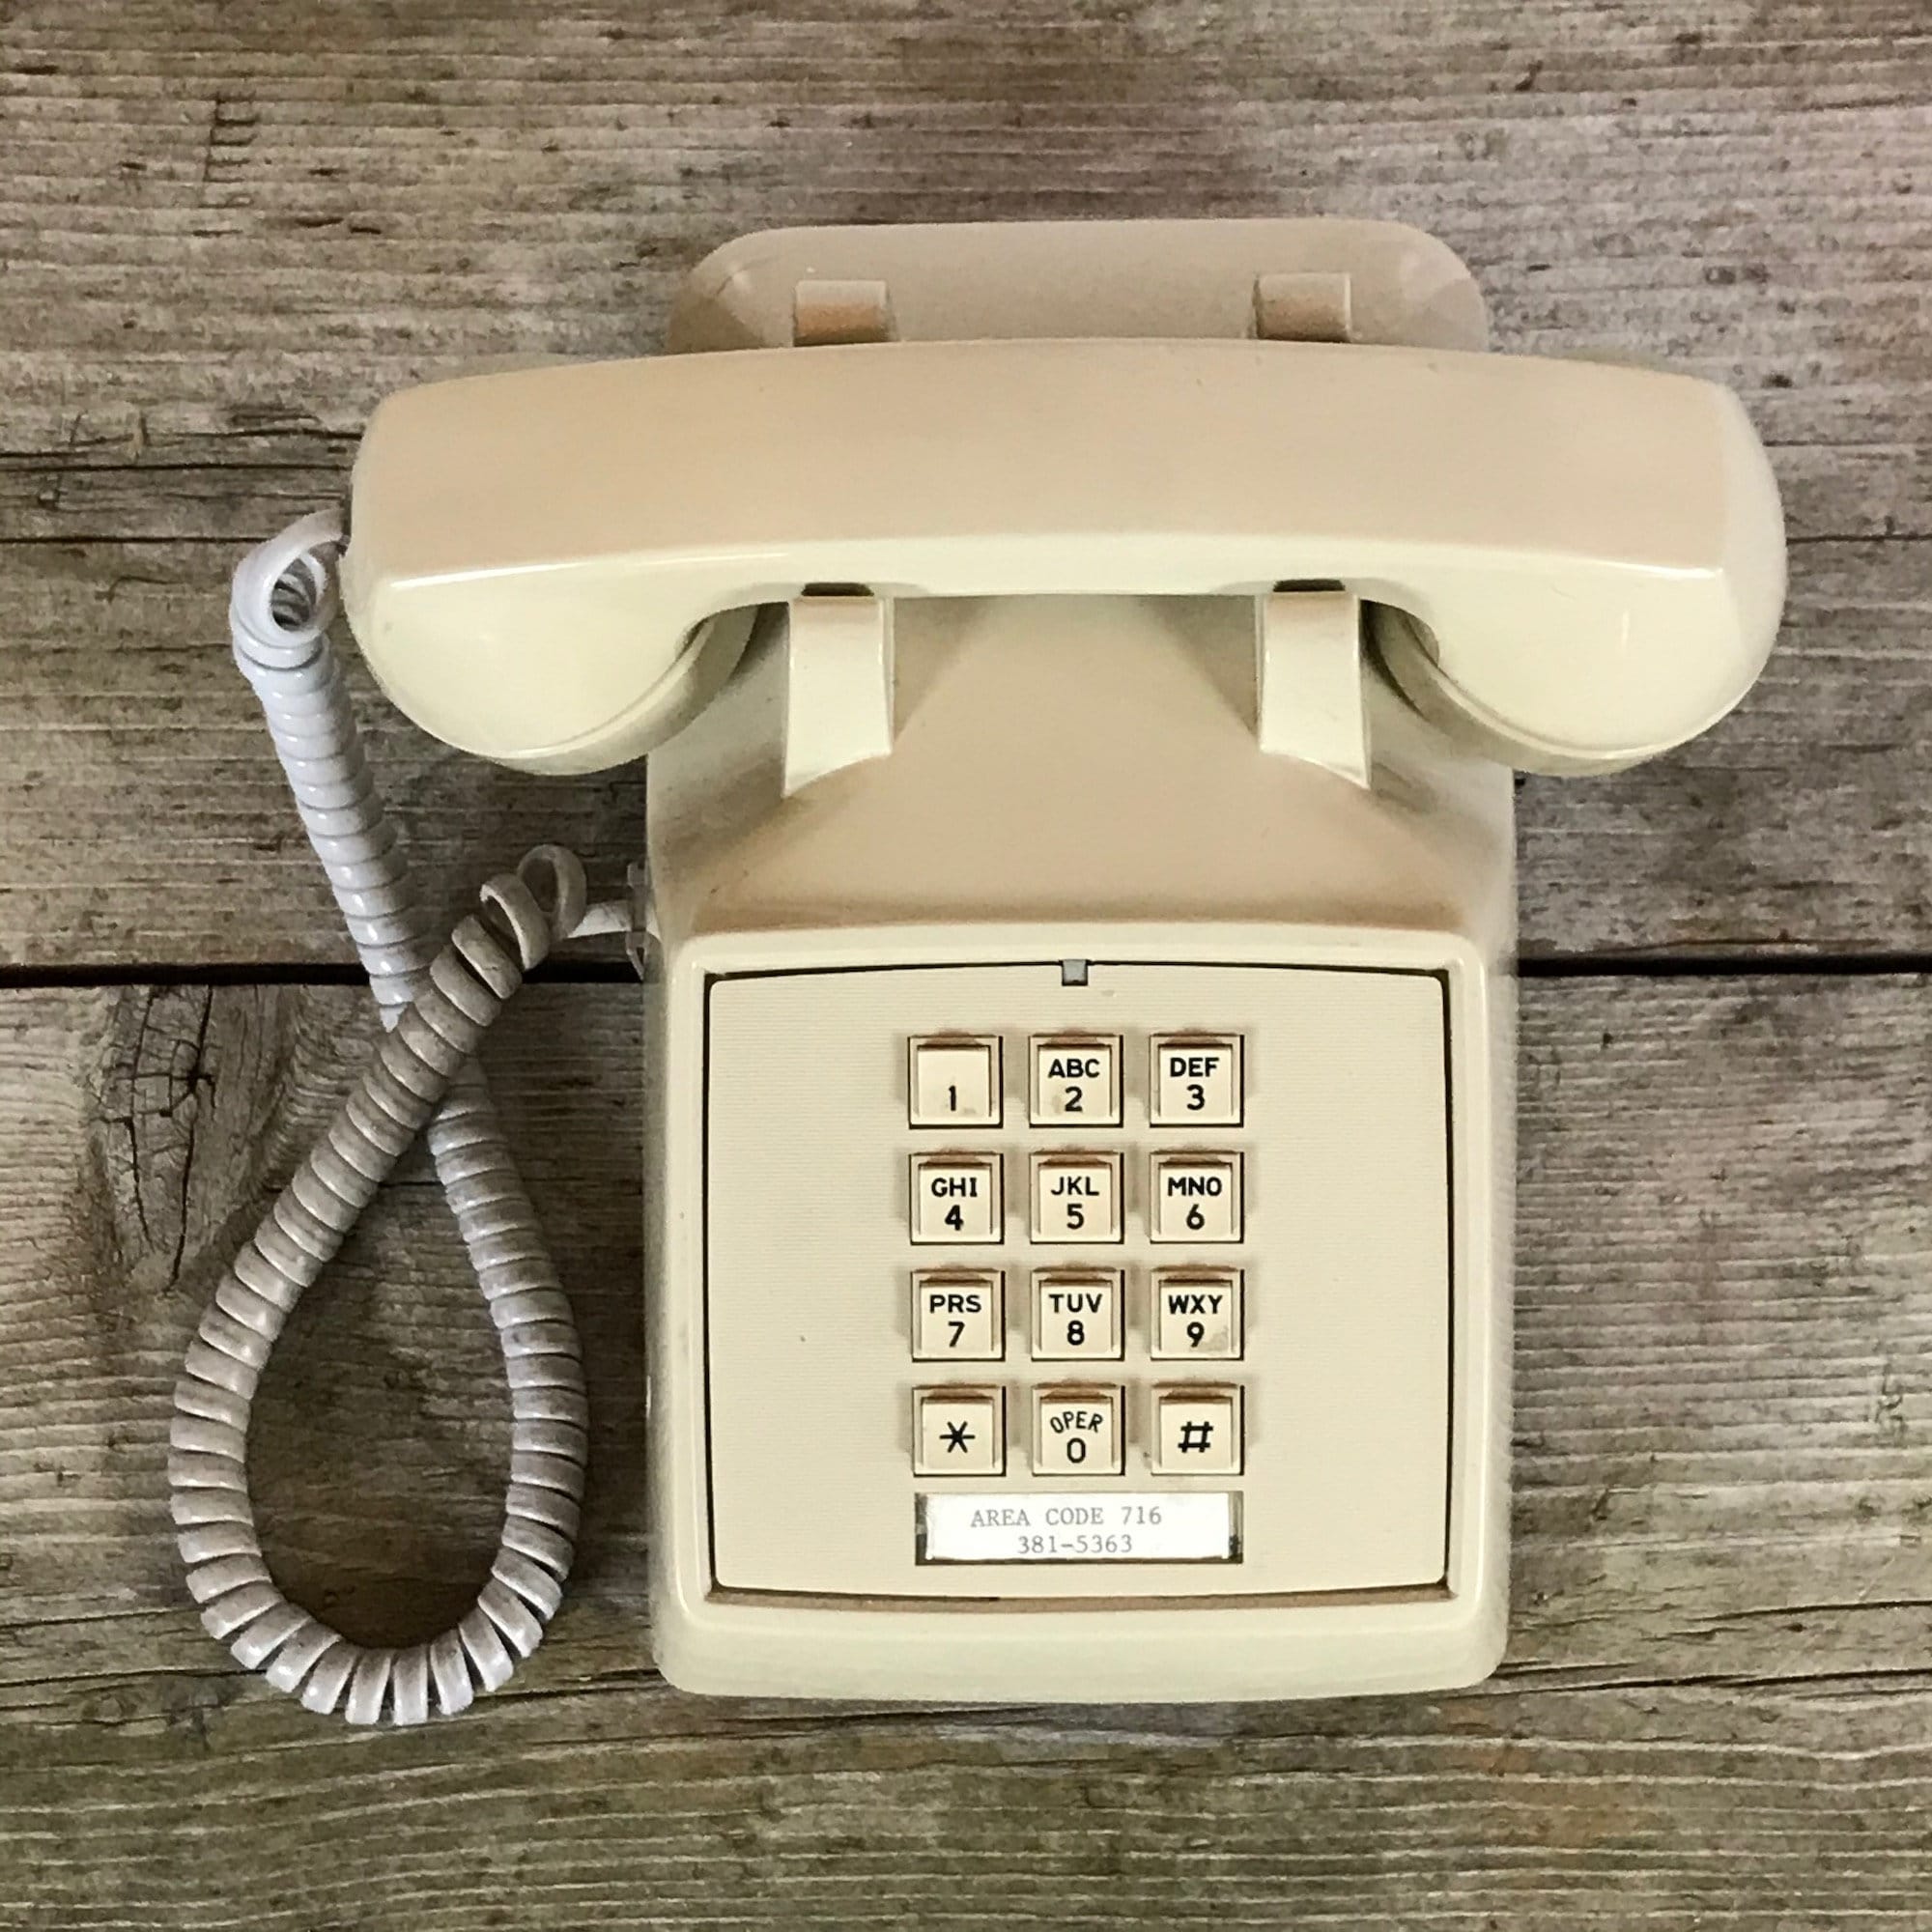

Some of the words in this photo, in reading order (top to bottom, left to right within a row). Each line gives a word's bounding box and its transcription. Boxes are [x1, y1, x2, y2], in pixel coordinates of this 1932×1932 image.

[1047, 1058, 1101, 1079] ABC
[1169, 1057, 1220, 1078] DEF
[948, 1085, 957, 1112] 1
[1065, 1086, 1084, 1112] 2
[1186, 1084, 1206, 1111] 3
[931, 1177, 978, 1198] GHI
[1050, 1176, 1100, 1197] JKL
[1167, 1177, 1223, 1197] MNO
[944, 1205, 964, 1232] 4
[1066, 1203, 1085, 1230] 5
[1186, 1204, 1206, 1231] 6
[929, 1293, 982, 1314] PRS
[1048, 1293, 1103, 1314] TUV
[1168, 1294, 1224, 1315] WXY
[948, 1321, 965, 1348] 7
[1066, 1320, 1085, 1346] 8
[1186, 1321, 1205, 1348] 9
[1050, 1410, 1103, 1434] OPER
[970, 1508, 1031, 1528] AREA
[1045, 1507, 1104, 1526] CODE
[1122, 1506, 1163, 1525] 716
[1017, 1534, 1134, 1555] 381-5363
